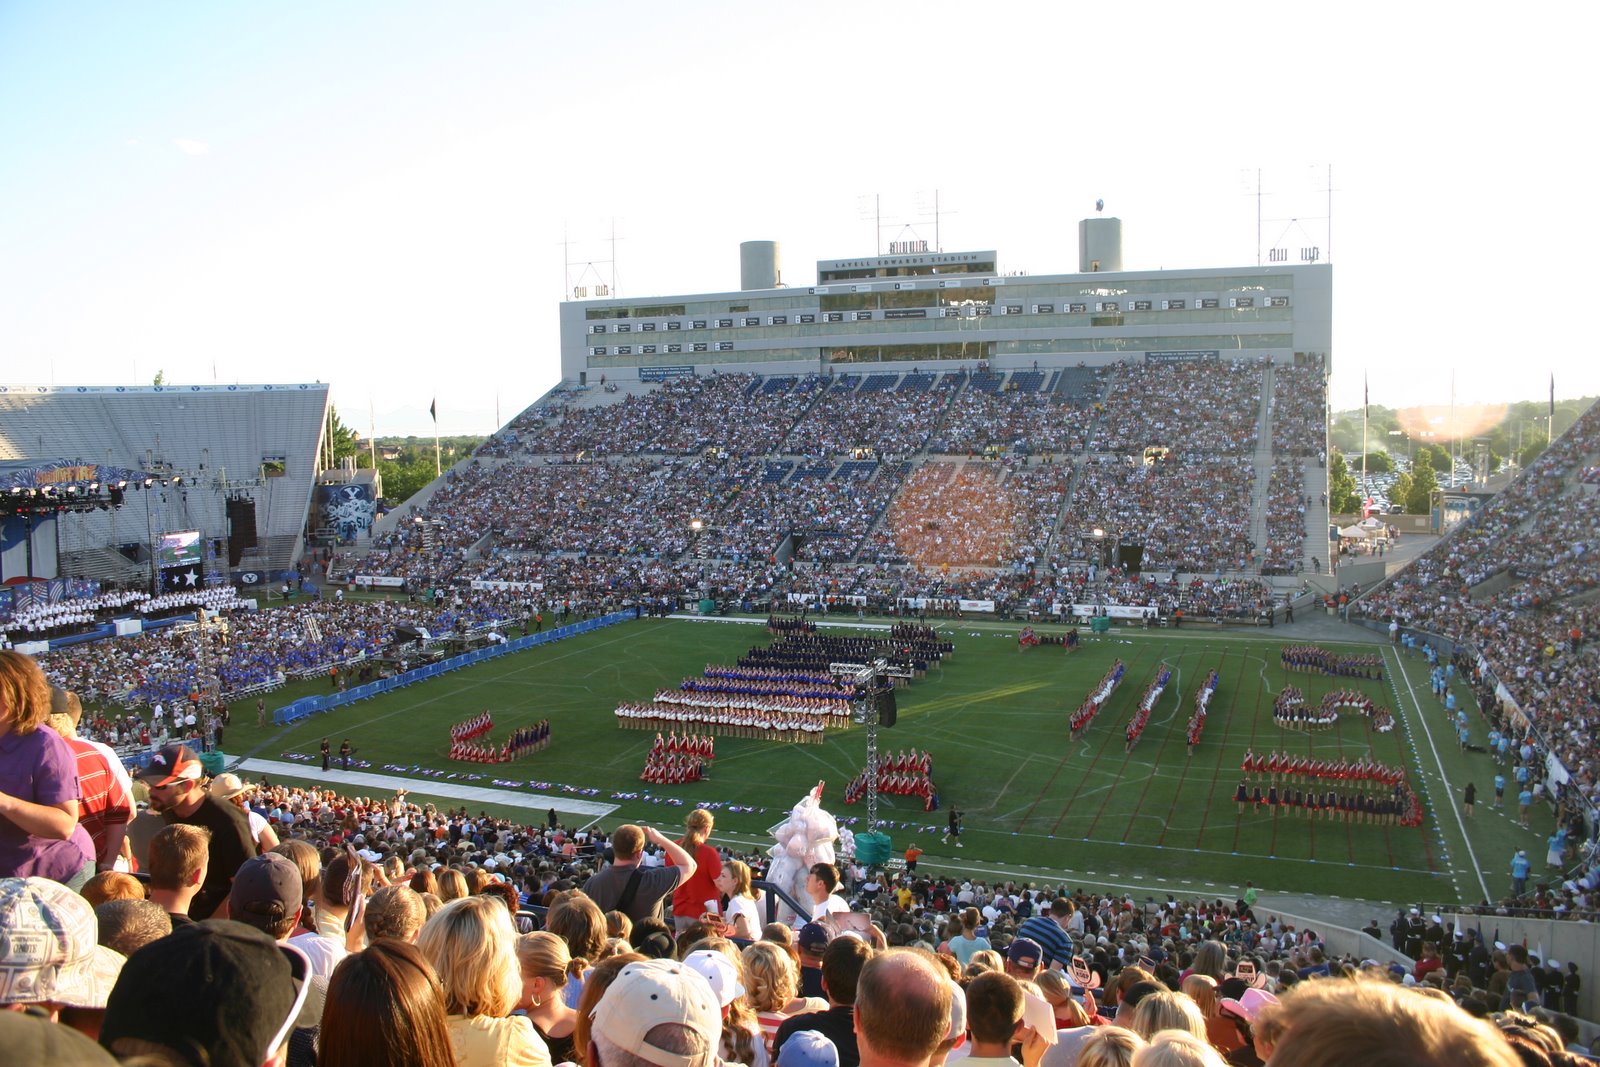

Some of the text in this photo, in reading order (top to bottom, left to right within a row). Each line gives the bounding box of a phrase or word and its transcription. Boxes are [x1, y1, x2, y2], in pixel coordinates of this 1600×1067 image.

[878, 257, 924, 266] EDWARDS
[932, 255, 977, 263] STADIUM
[344, 487, 360, 499] Y
[356, 517, 366, 529] 51
